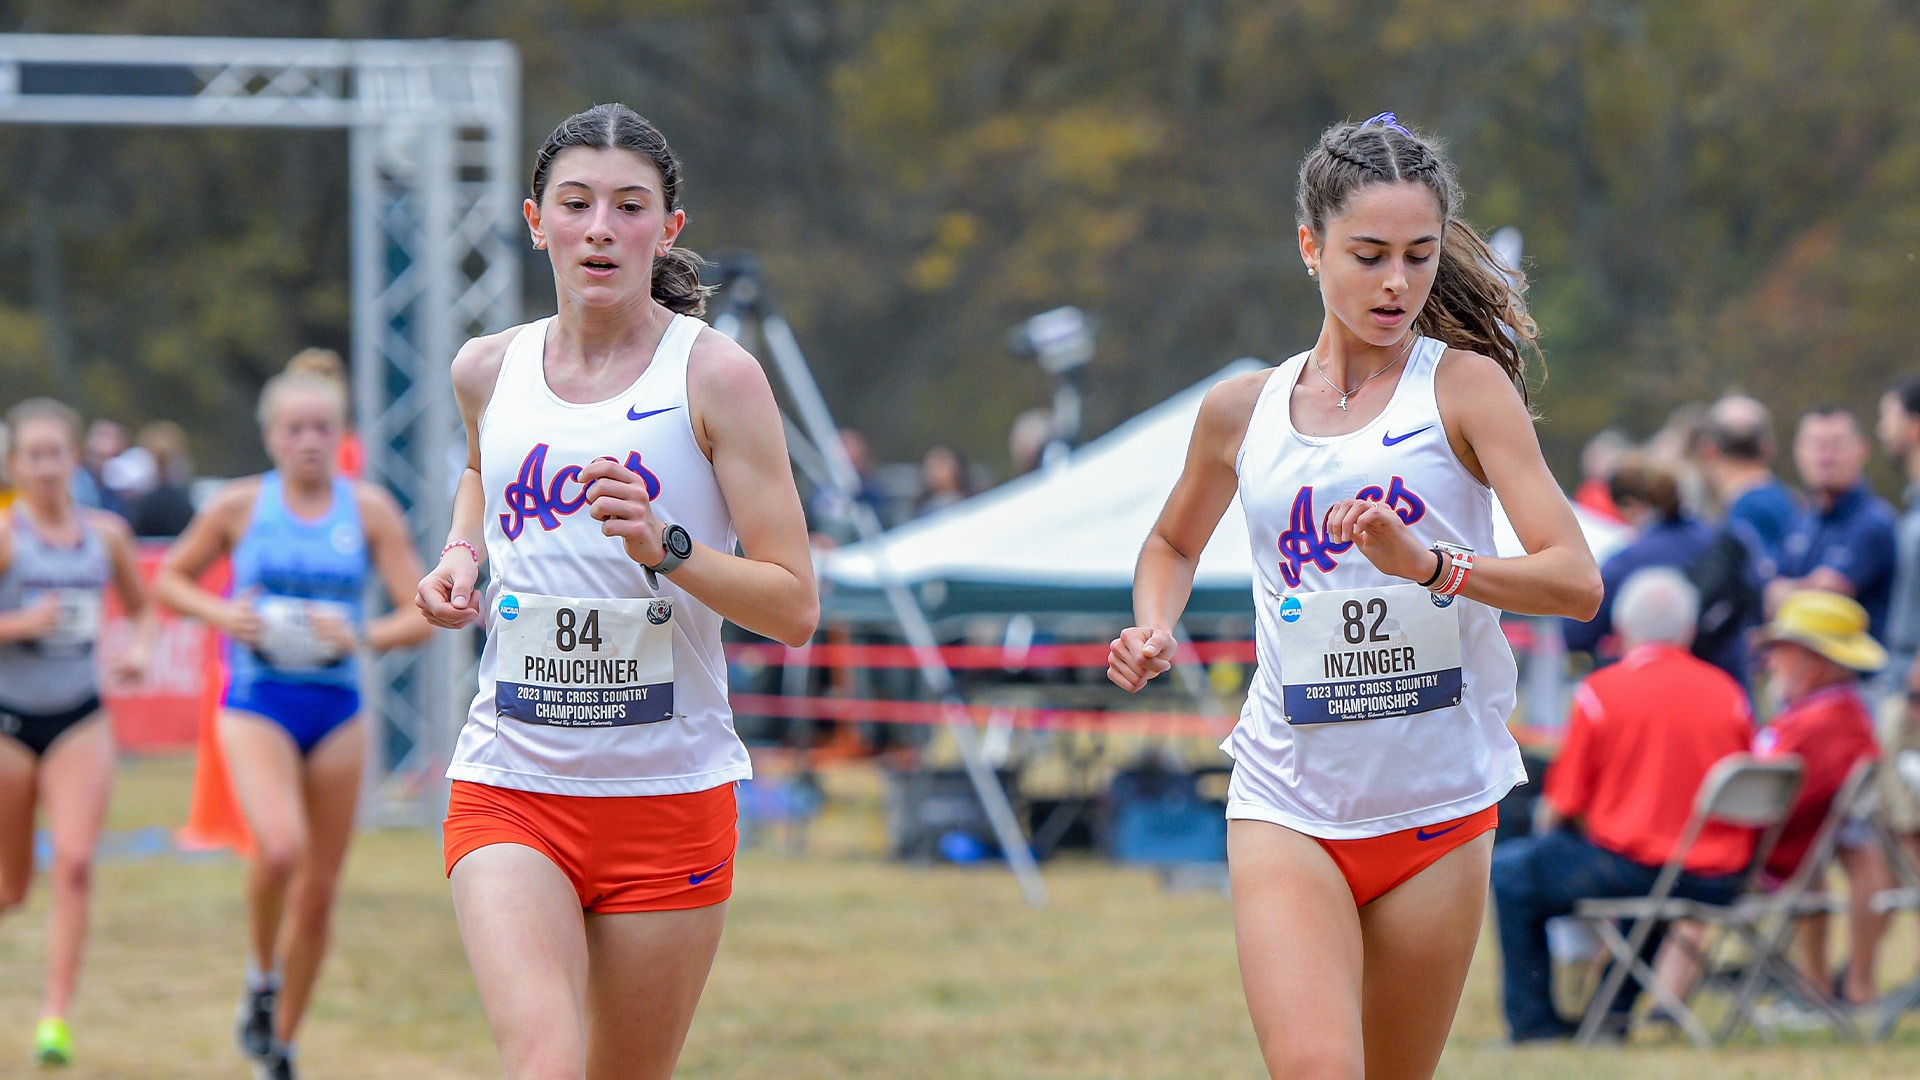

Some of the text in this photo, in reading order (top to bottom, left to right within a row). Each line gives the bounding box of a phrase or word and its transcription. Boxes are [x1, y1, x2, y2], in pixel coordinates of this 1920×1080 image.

[499, 443, 661, 542] Acs
[500, 605, 519, 615] NCAA
[1282, 608, 1302, 617] NCAA
[1342, 598, 1390, 644] 82
[555, 607, 603, 652] 84
[524, 655, 639, 684] PRAUCHNER
[1324, 646, 1416, 679] INZINGER
[517, 686, 648, 704] 2023 MVC CROSS COUNTRY
[1306, 674, 1438, 699] 2023 MVC CROSS COUNTRY
[535, 703, 626, 720] CHAMPIONSHIPS
[1328, 691, 1419, 715] CHAMPIONSHIPS
